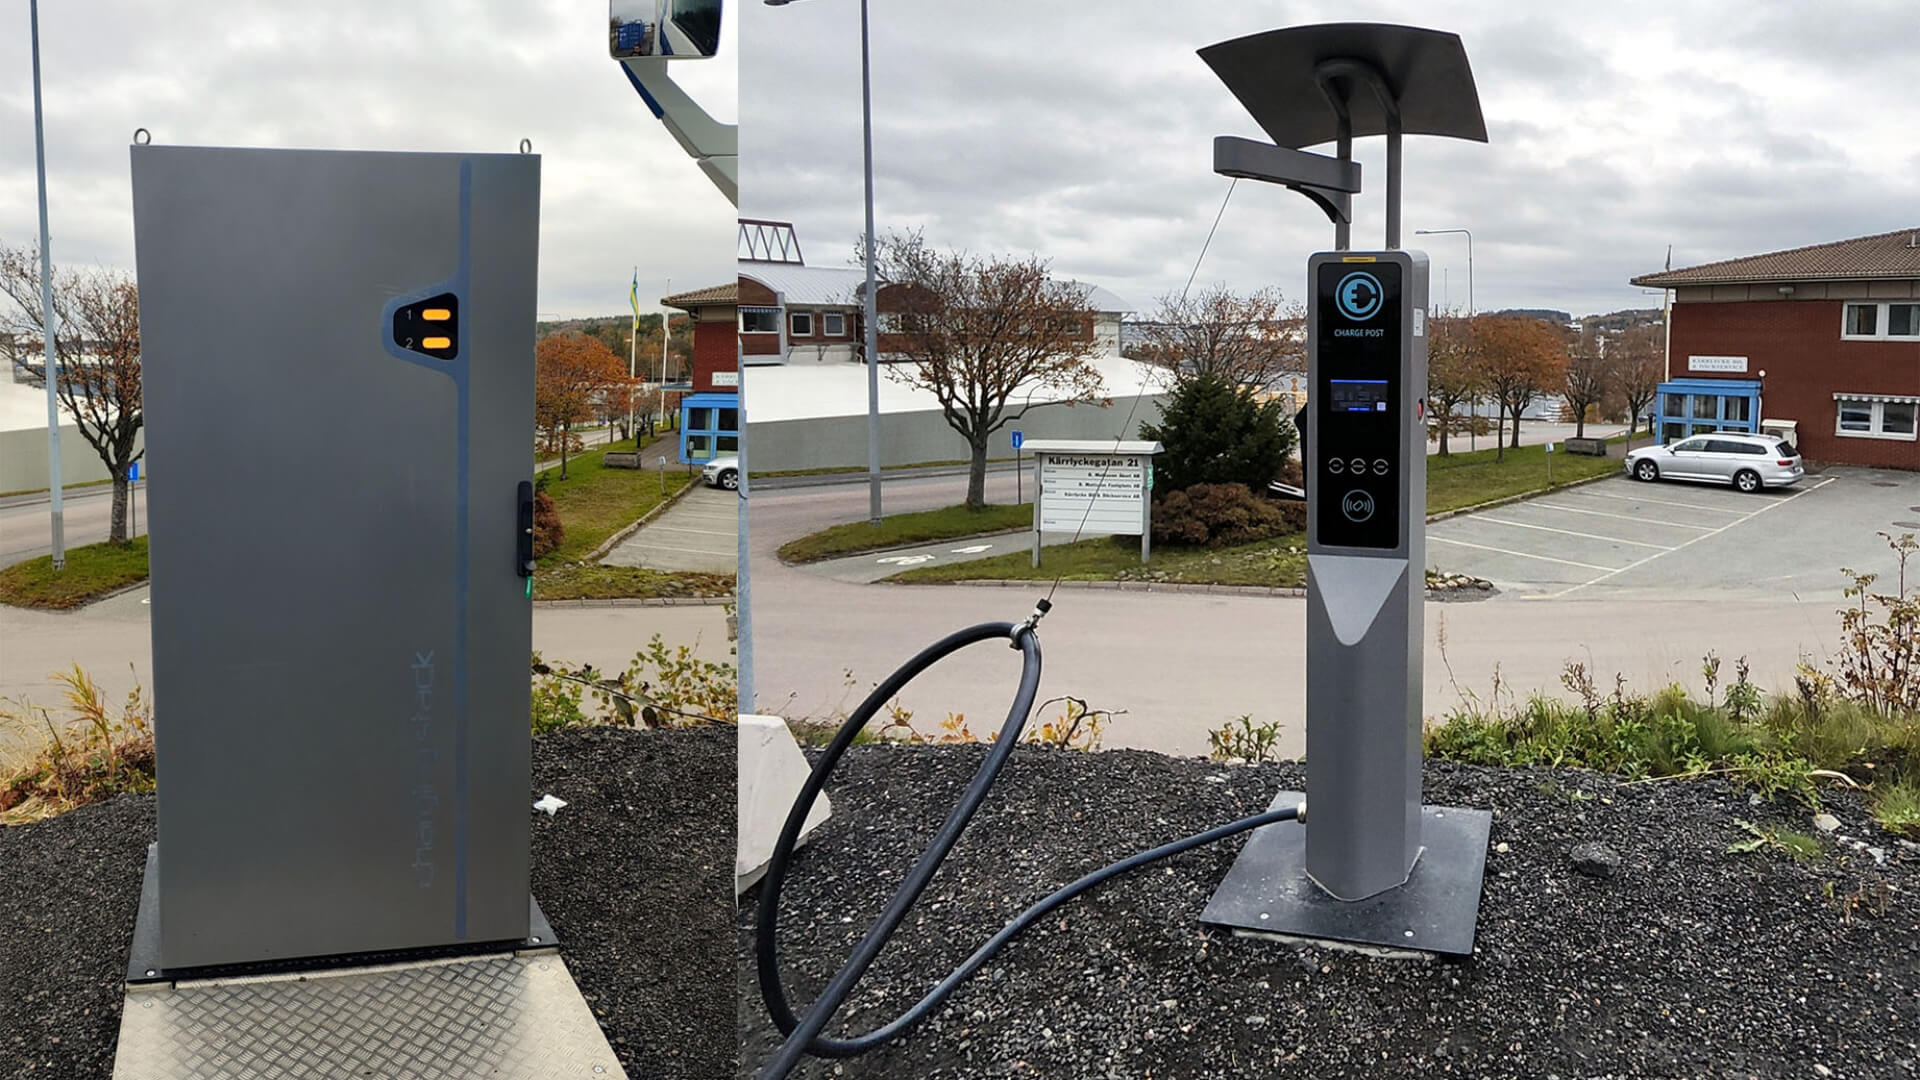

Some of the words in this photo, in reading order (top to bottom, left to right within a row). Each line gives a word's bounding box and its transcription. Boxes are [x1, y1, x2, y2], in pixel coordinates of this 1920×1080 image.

[406, 309, 412, 320] 1
[1334, 328, 1364, 337] CHARGE
[1365, 328, 1384, 337] POST
[405, 337, 414, 349] 2
[1048, 456, 1123, 467] Kärrlyckegatan
[1127, 458, 1139, 467] 21
